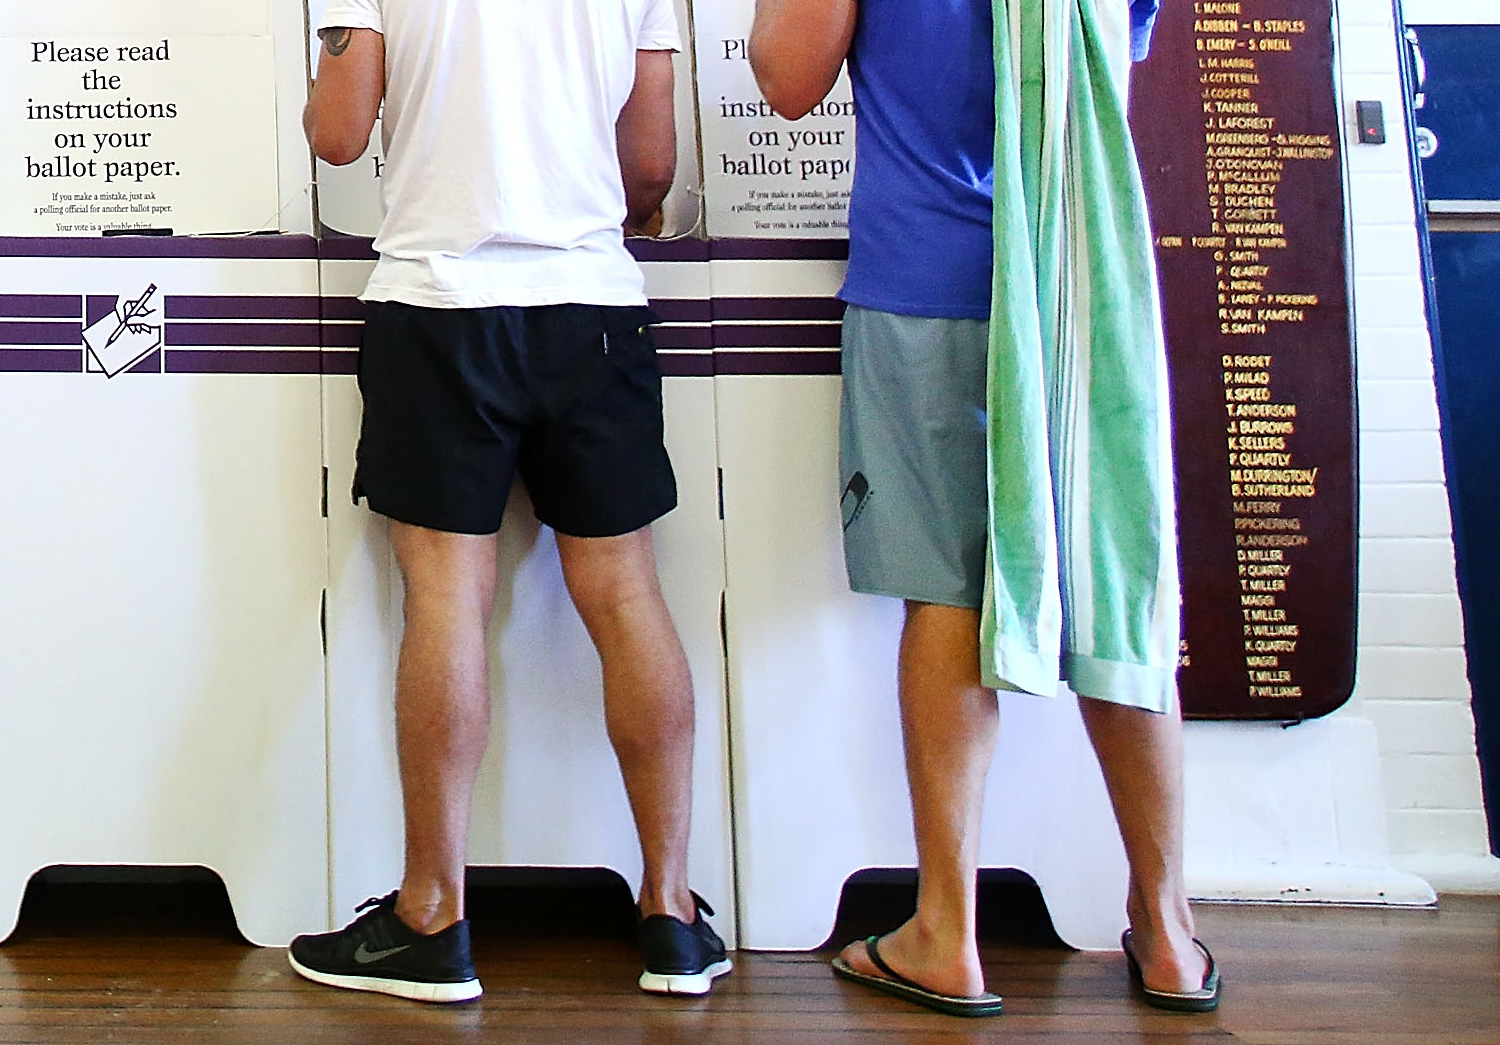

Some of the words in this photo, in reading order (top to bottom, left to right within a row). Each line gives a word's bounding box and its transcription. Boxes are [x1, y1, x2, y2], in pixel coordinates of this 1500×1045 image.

[31, 41, 109, 62] Please
[117, 39, 170, 61] read
[81, 69, 122, 90] the
[27, 97, 178, 120] instructions
[54, 132, 86, 148] on
[92, 132, 152, 153] your
[750, 131, 779, 146] on
[788, 130, 845, 151] your
[24, 156, 97, 178] ballot
[103, 161, 181, 183] paper.
[719, 154, 792, 176] ballot
[52, 192, 58, 201] If
[59, 194, 72, 204] you
[74, 192, 92, 201] make
[100, 192, 128, 202] mistake,
[129, 192, 142, 203] just
[144, 191, 156, 200] ask
[40, 205, 63, 215] polling
[65, 204, 88, 213] official
[90, 204, 100, 213] for
[102, 205, 128, 213] another
[130, 203, 149, 212] ballot
[56, 222, 73, 232] Your
[90, 222, 95, 231] is
